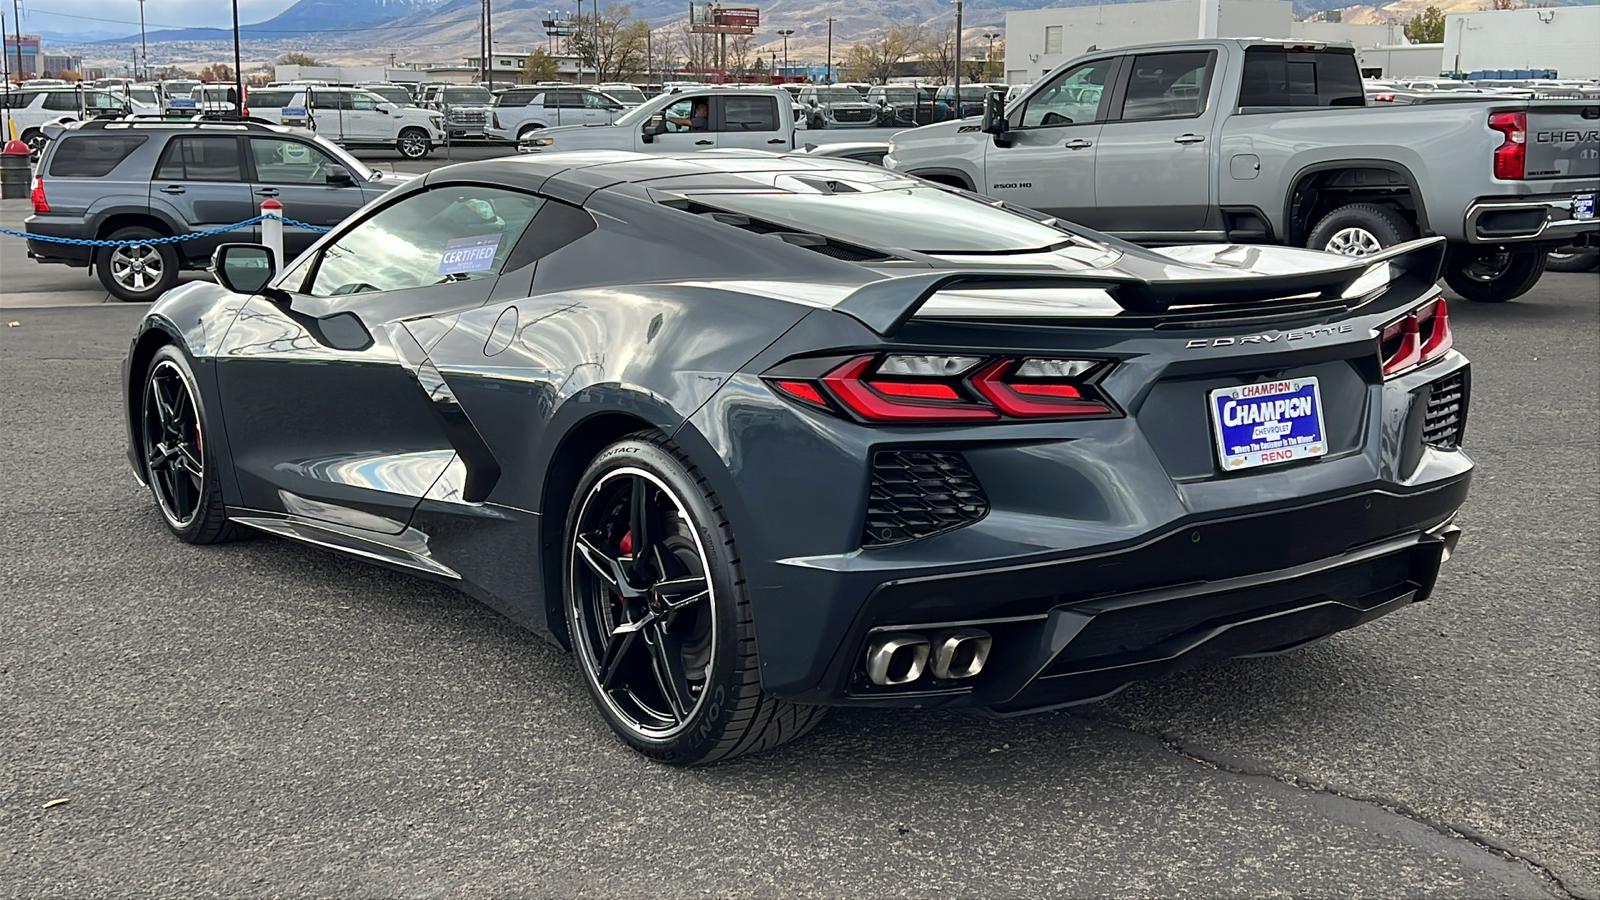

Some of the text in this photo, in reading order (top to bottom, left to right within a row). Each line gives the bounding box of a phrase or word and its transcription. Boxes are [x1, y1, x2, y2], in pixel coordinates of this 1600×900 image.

[1537, 131, 1599, 143] CHEVR
[443, 248, 494, 263] CERTIFIED
[1186, 324, 1353, 349] CORVETTE
[1242, 382, 1291, 397] CHAMPION
[1223, 397, 1311, 427] CHAMPION
[1255, 425, 1289, 436] CHEVROLET
[1261, 450, 1293, 463] RENO
